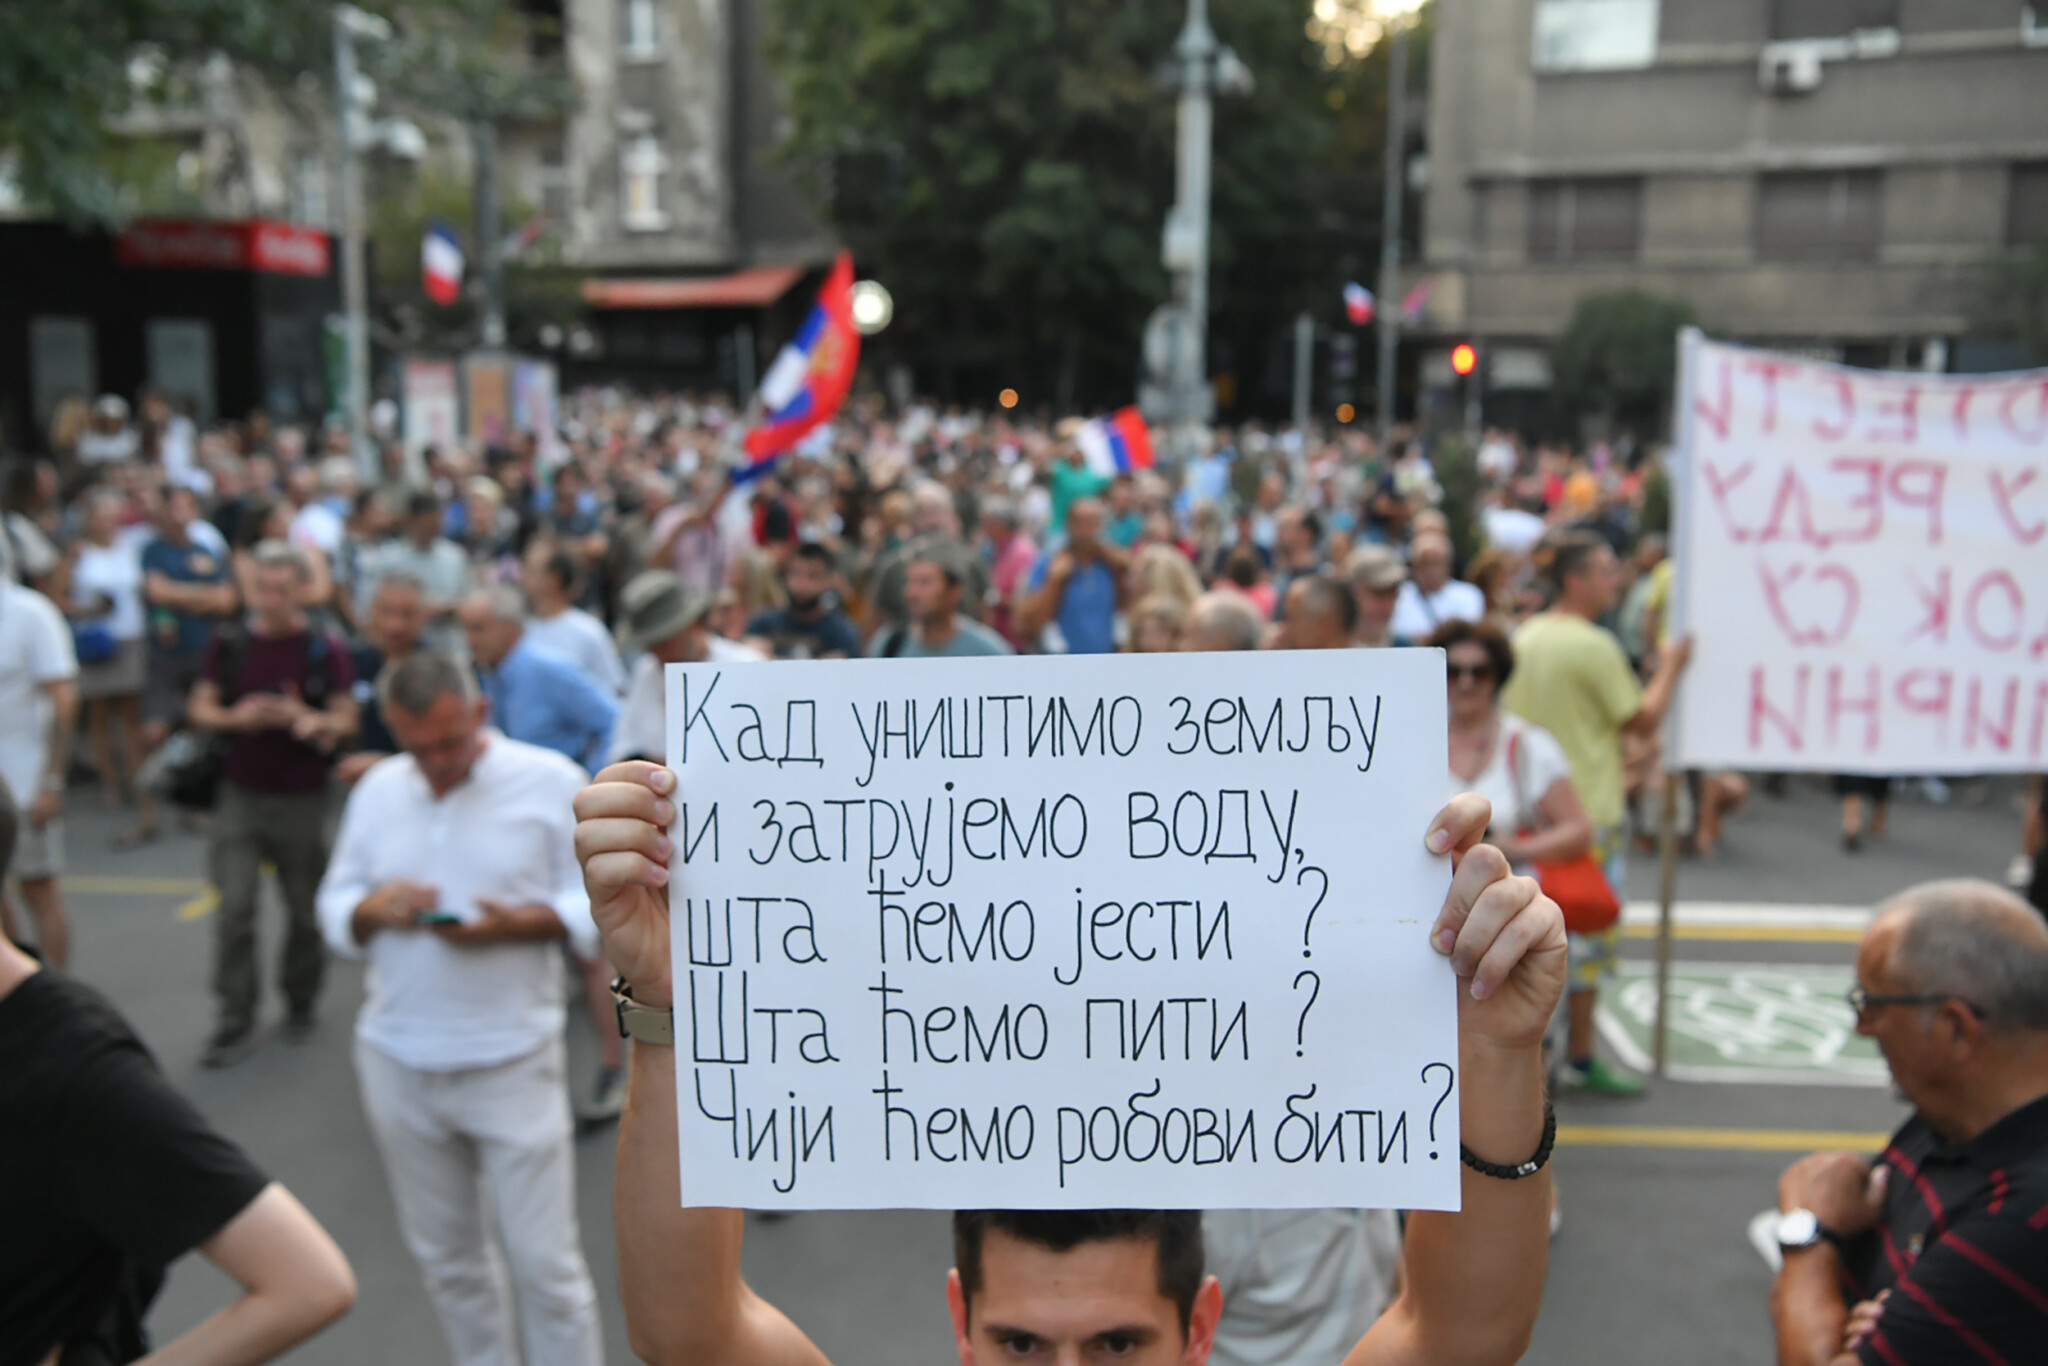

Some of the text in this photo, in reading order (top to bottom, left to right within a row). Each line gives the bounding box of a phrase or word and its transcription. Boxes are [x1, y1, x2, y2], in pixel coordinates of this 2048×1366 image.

[682, 671, 1381, 787] Кад уништимо земљу
[682, 782, 1305, 887] и затрујемо воду,
[686, 866, 1329, 986] шта ћемо јести ?
[689, 969, 1321, 1065] Шта ћемо пити ?
[694, 1067, 835, 1194] Чији
[871, 1069, 1035, 1164] ћемо
[1057, 1078, 1258, 1189] робови
